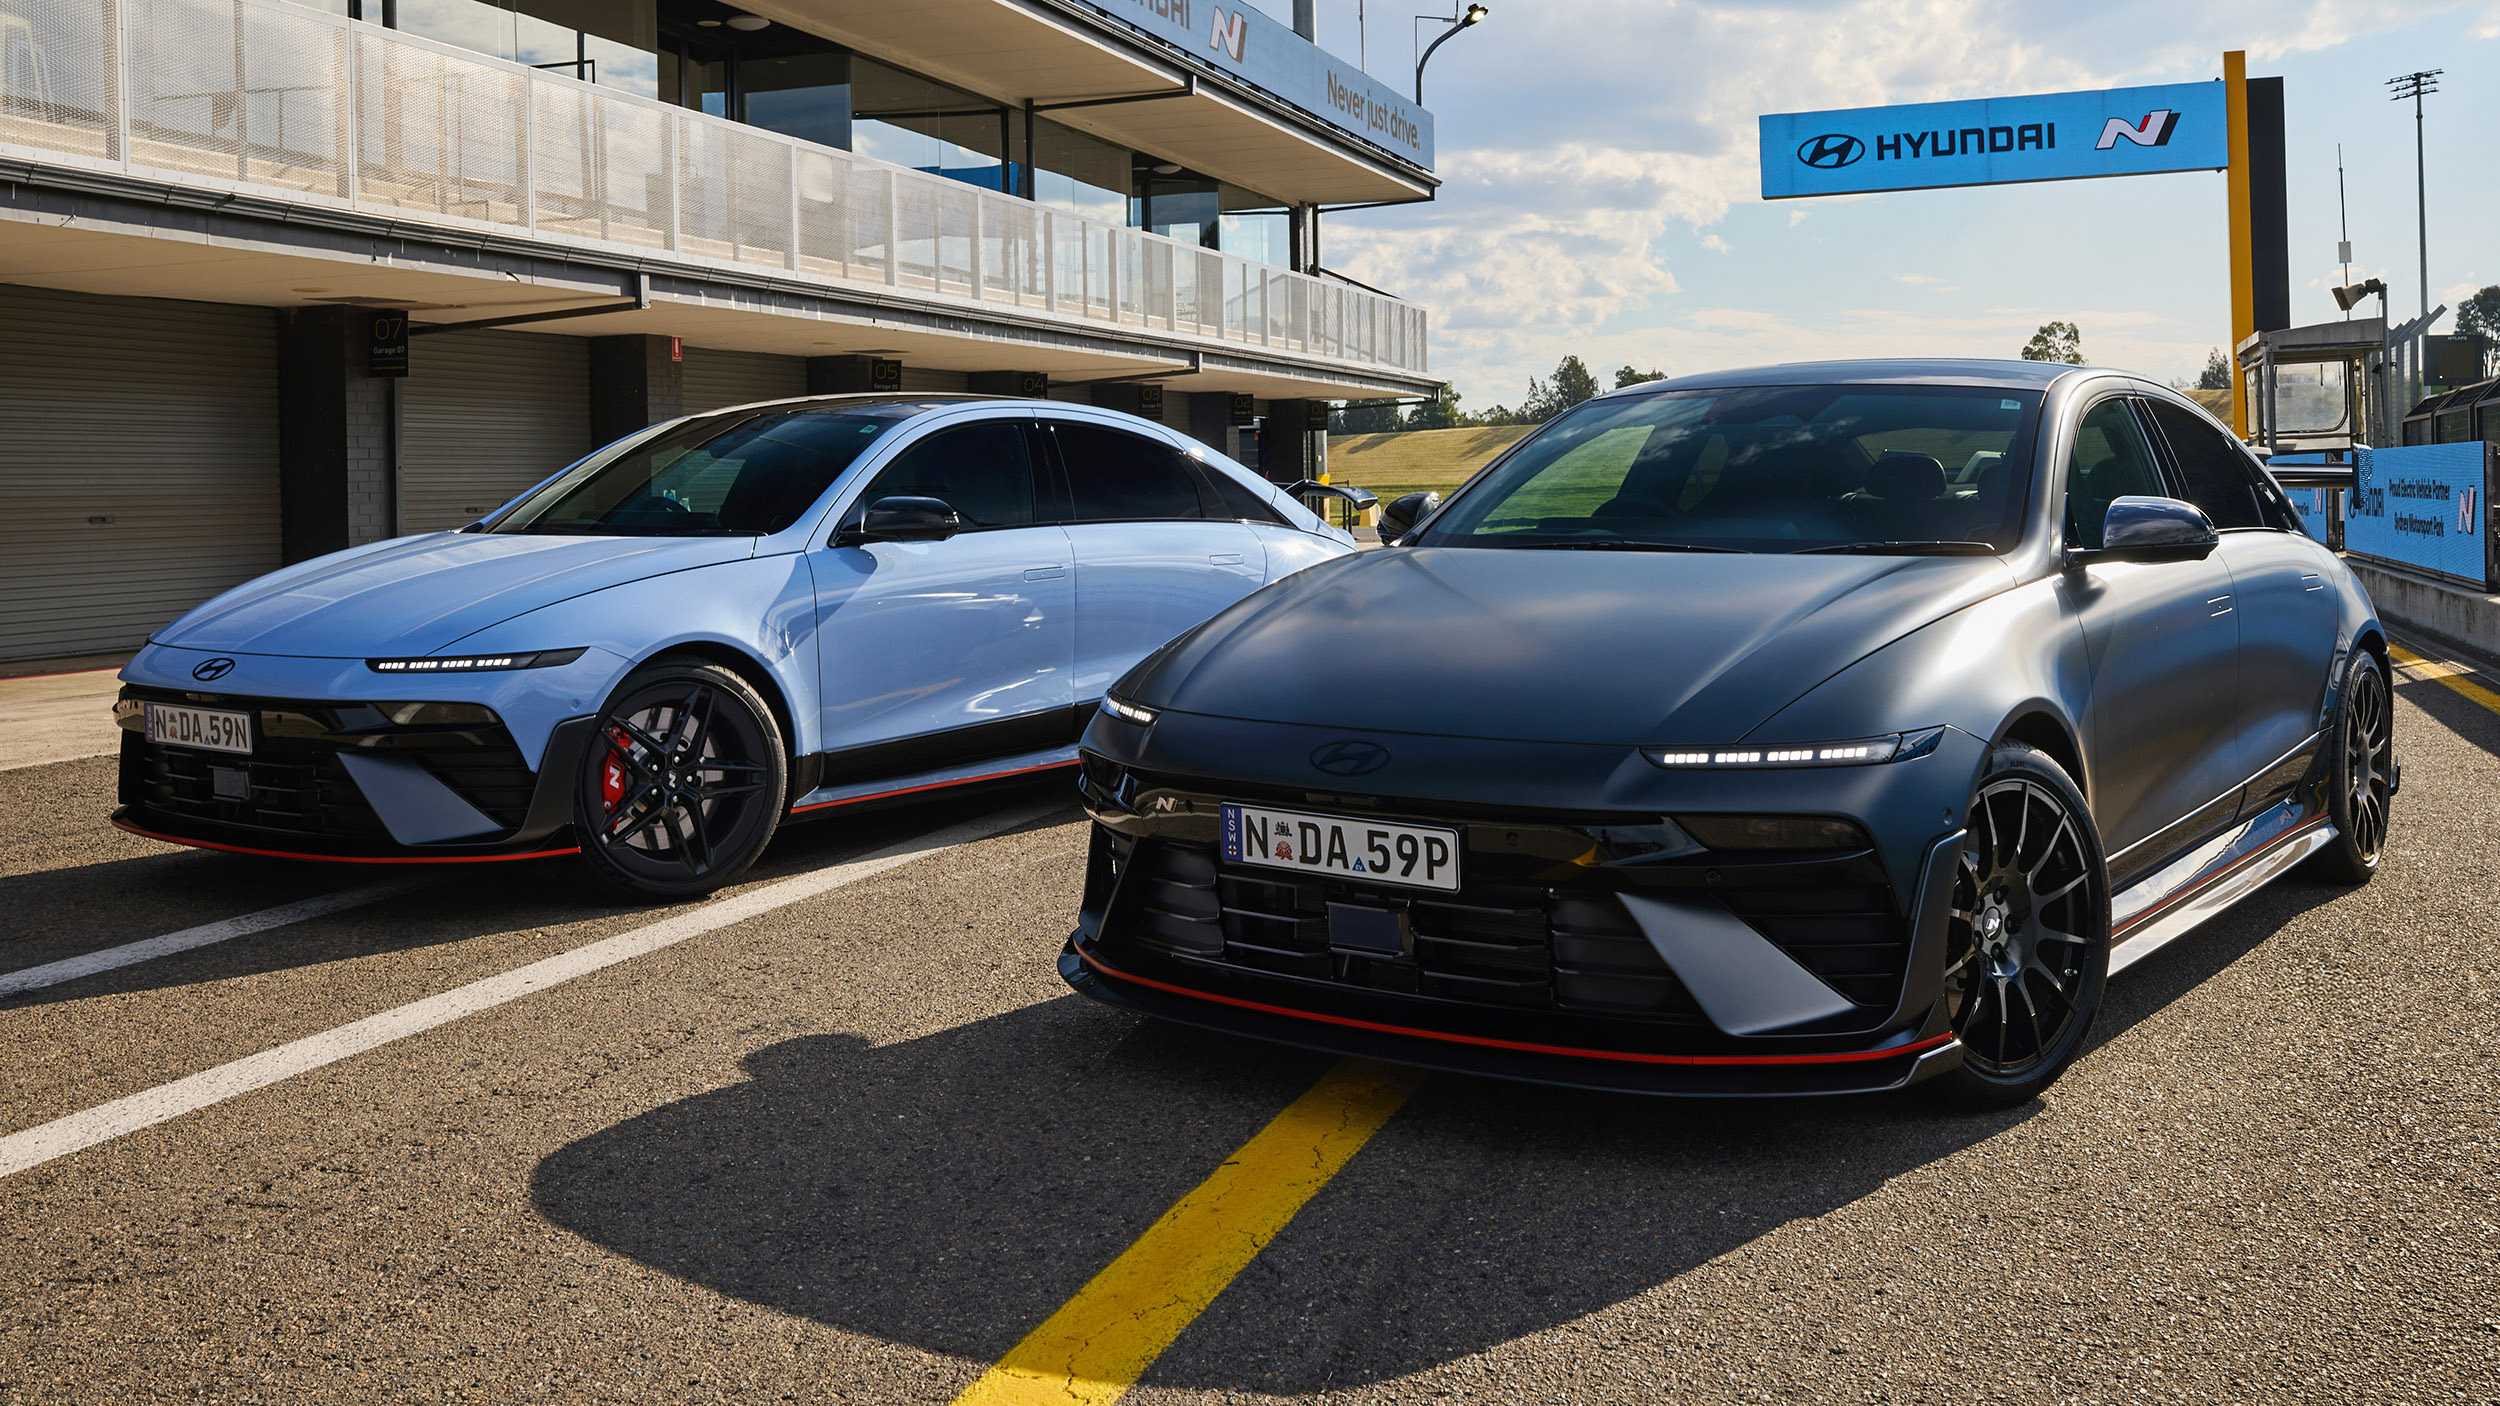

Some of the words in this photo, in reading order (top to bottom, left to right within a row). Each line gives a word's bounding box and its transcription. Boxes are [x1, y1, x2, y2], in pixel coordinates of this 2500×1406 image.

[1327, 69, 1365, 120] Never
[1367, 88, 1388, 132] just
[1390, 106, 1420, 150] drive.
[1877, 122, 2055, 161] HYUNDAI
[375, 318, 402, 340] 07
[373, 346, 396, 355] Garage
[396, 346, 405, 354] 07
[875, 364, 898, 380] 05
[1024, 377, 1044, 392] 04
[1142, 388, 1161, 400] 03
[2389, 478, 2401, 497] Proud
[2401, 478, 2415, 498] Electric
[2415, 478, 2432, 499] Vehicle
[2432, 480, 2450, 500] Partner
[2394, 511, 2408, 536] Sydney
[2409, 513, 2433, 539] Motorsport
[2433, 515, 2444, 537] Park
[209, 715, 248, 749] 59N
[1227, 808, 1237, 842] NSW
[1367, 829, 1449, 881] 59P
